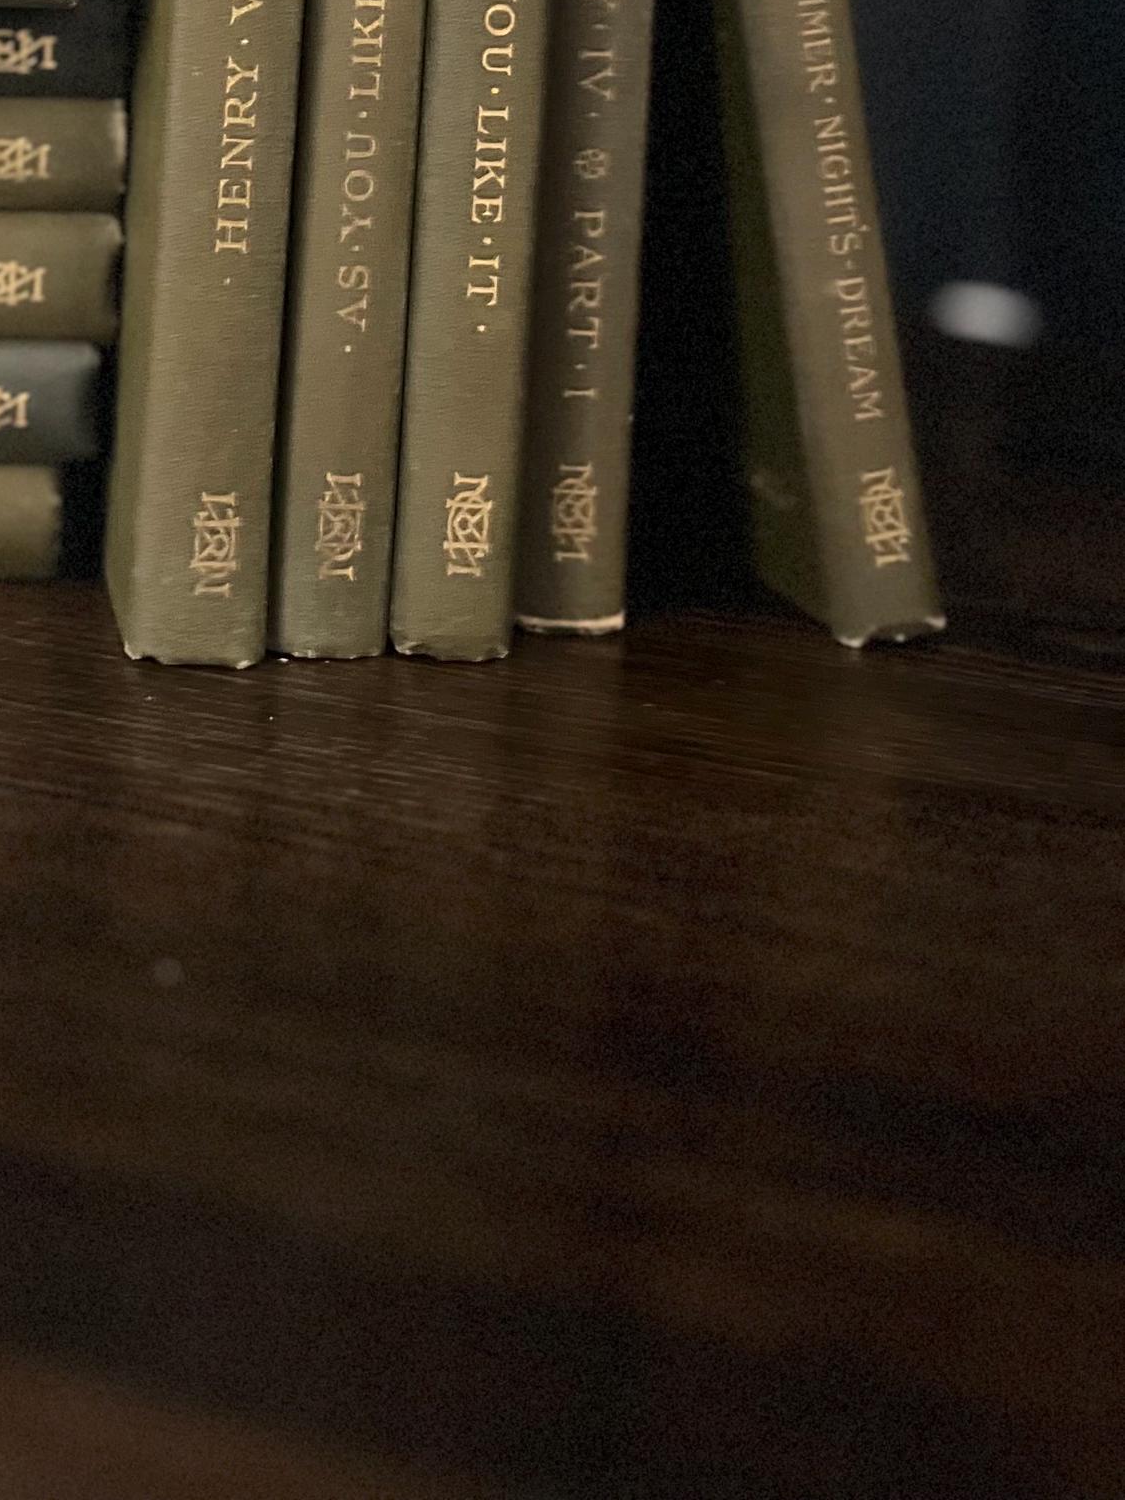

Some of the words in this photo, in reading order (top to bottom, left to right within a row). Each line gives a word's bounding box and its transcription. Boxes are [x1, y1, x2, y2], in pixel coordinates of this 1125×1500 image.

[576, 49, 615, 101] IV
[214, 55, 260, 254] HENRY
[340, 131, 377, 245] YOU
[470, 104, 510, 224] LIKE
[813, 113, 869, 257] NIGHT'S
[335, 263, 371, 333] AS
[466, 254, 500, 307] IT
[567, 209, 607, 350] PART
[563, 388, 596, 399] I
[831, 276, 885, 421] DREAM
